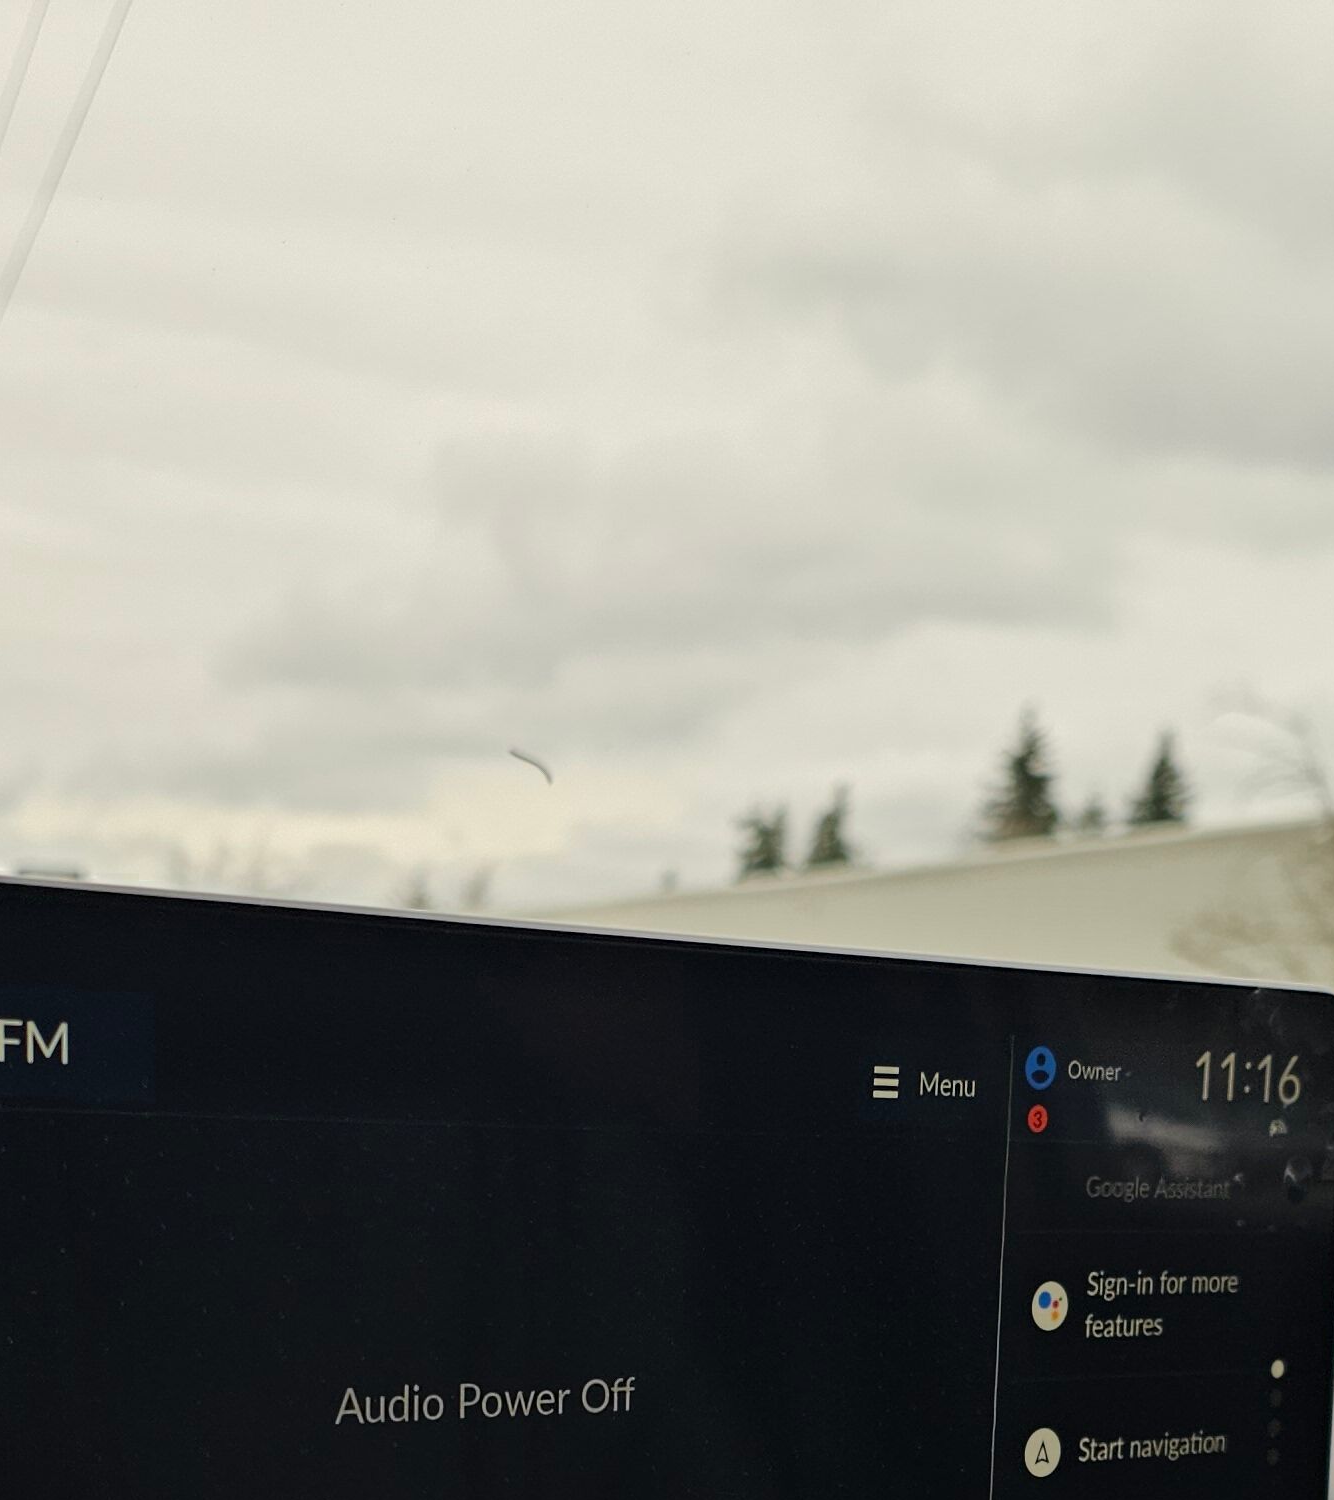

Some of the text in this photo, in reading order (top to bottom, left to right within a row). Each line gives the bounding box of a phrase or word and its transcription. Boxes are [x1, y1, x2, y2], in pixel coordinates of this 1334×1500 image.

[919, 1071, 976, 1098] Menu
[1068, 1063, 1122, 1083] Owner
[1195, 1050, 1302, 1104] 11:16
[1086, 1176, 1233, 1201] Google Assistant
[1086, 1270, 1239, 1301] Sign-in for more
[1085, 1313, 1163, 1338] features
[335, 1376, 636, 1425] Audio Power Off
[1078, 1430, 1227, 1462] Start navigation
